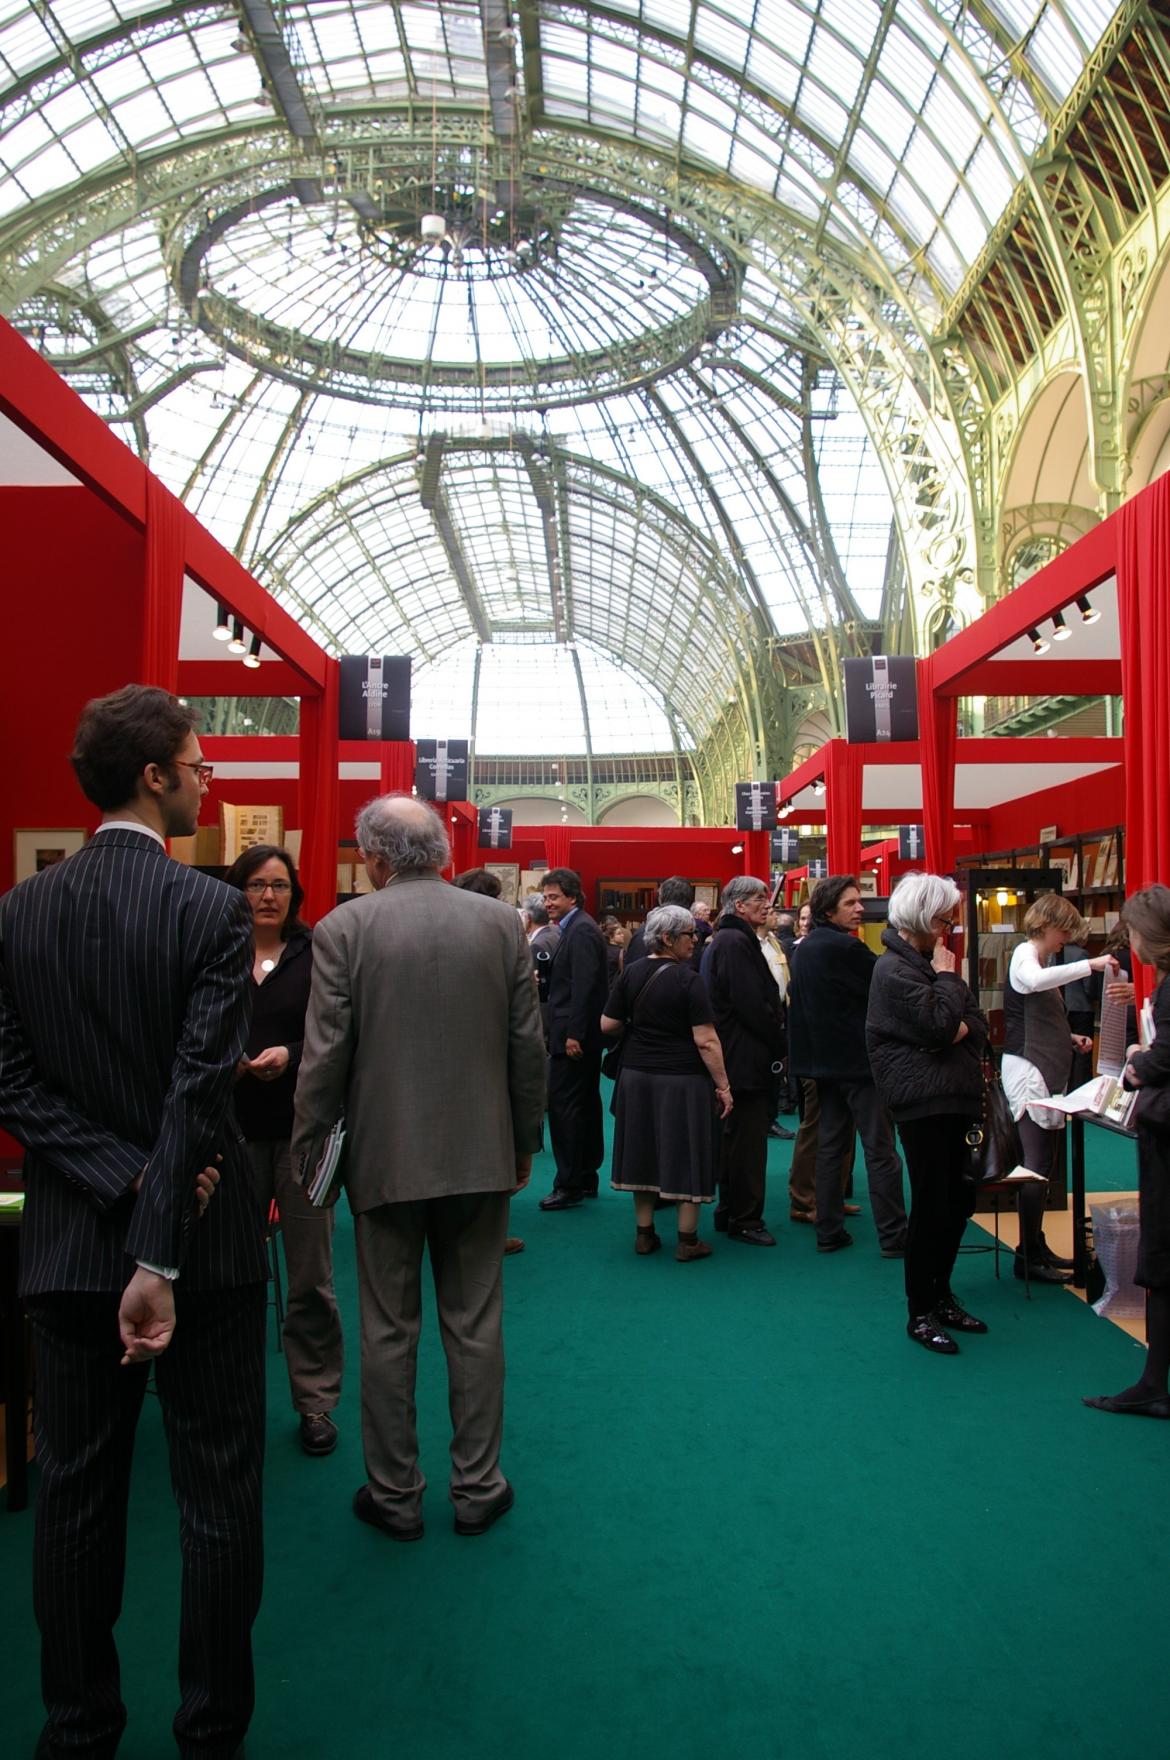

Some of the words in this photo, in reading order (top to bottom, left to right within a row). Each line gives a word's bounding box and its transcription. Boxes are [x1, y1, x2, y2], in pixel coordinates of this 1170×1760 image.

[865, 681, 897, 691] Librairie
[362, 690, 388, 698] Aldine
[870, 691, 893, 699] Picard
